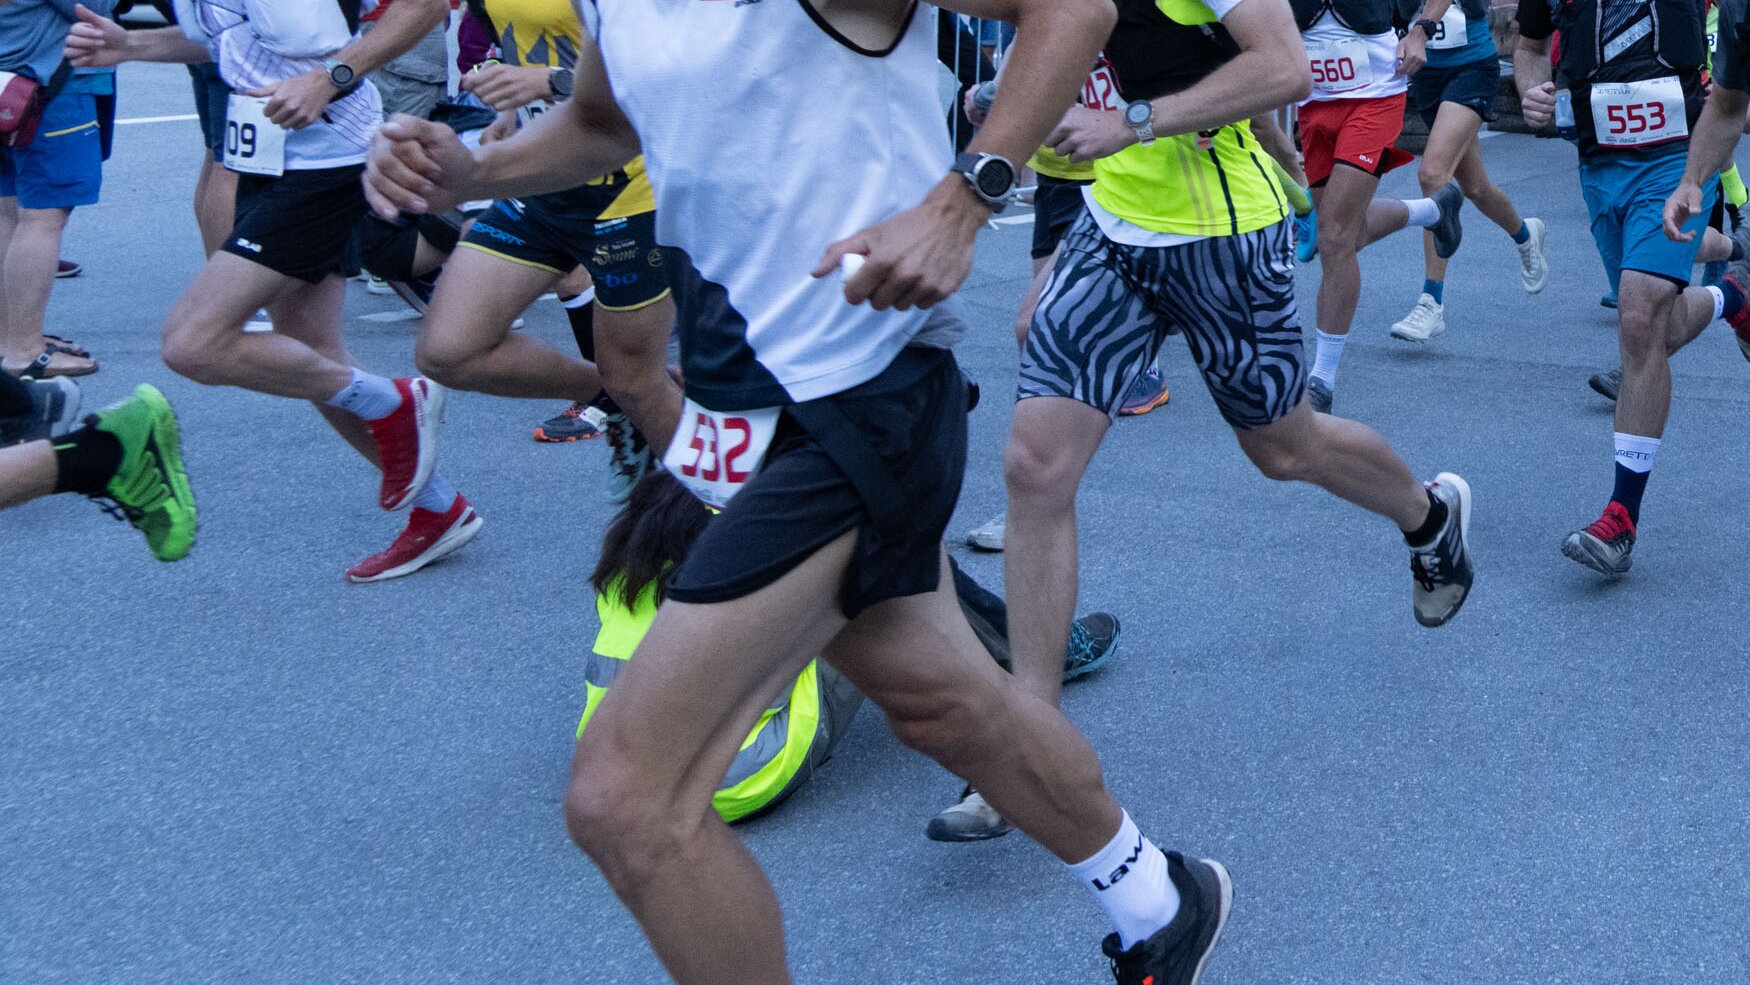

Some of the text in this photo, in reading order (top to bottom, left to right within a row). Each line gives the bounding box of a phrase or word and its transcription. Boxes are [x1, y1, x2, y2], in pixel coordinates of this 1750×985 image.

[1310, 56, 1355, 83] 560
[1607, 101, 1666, 134] 553
[681, 412, 753, 484] 532
